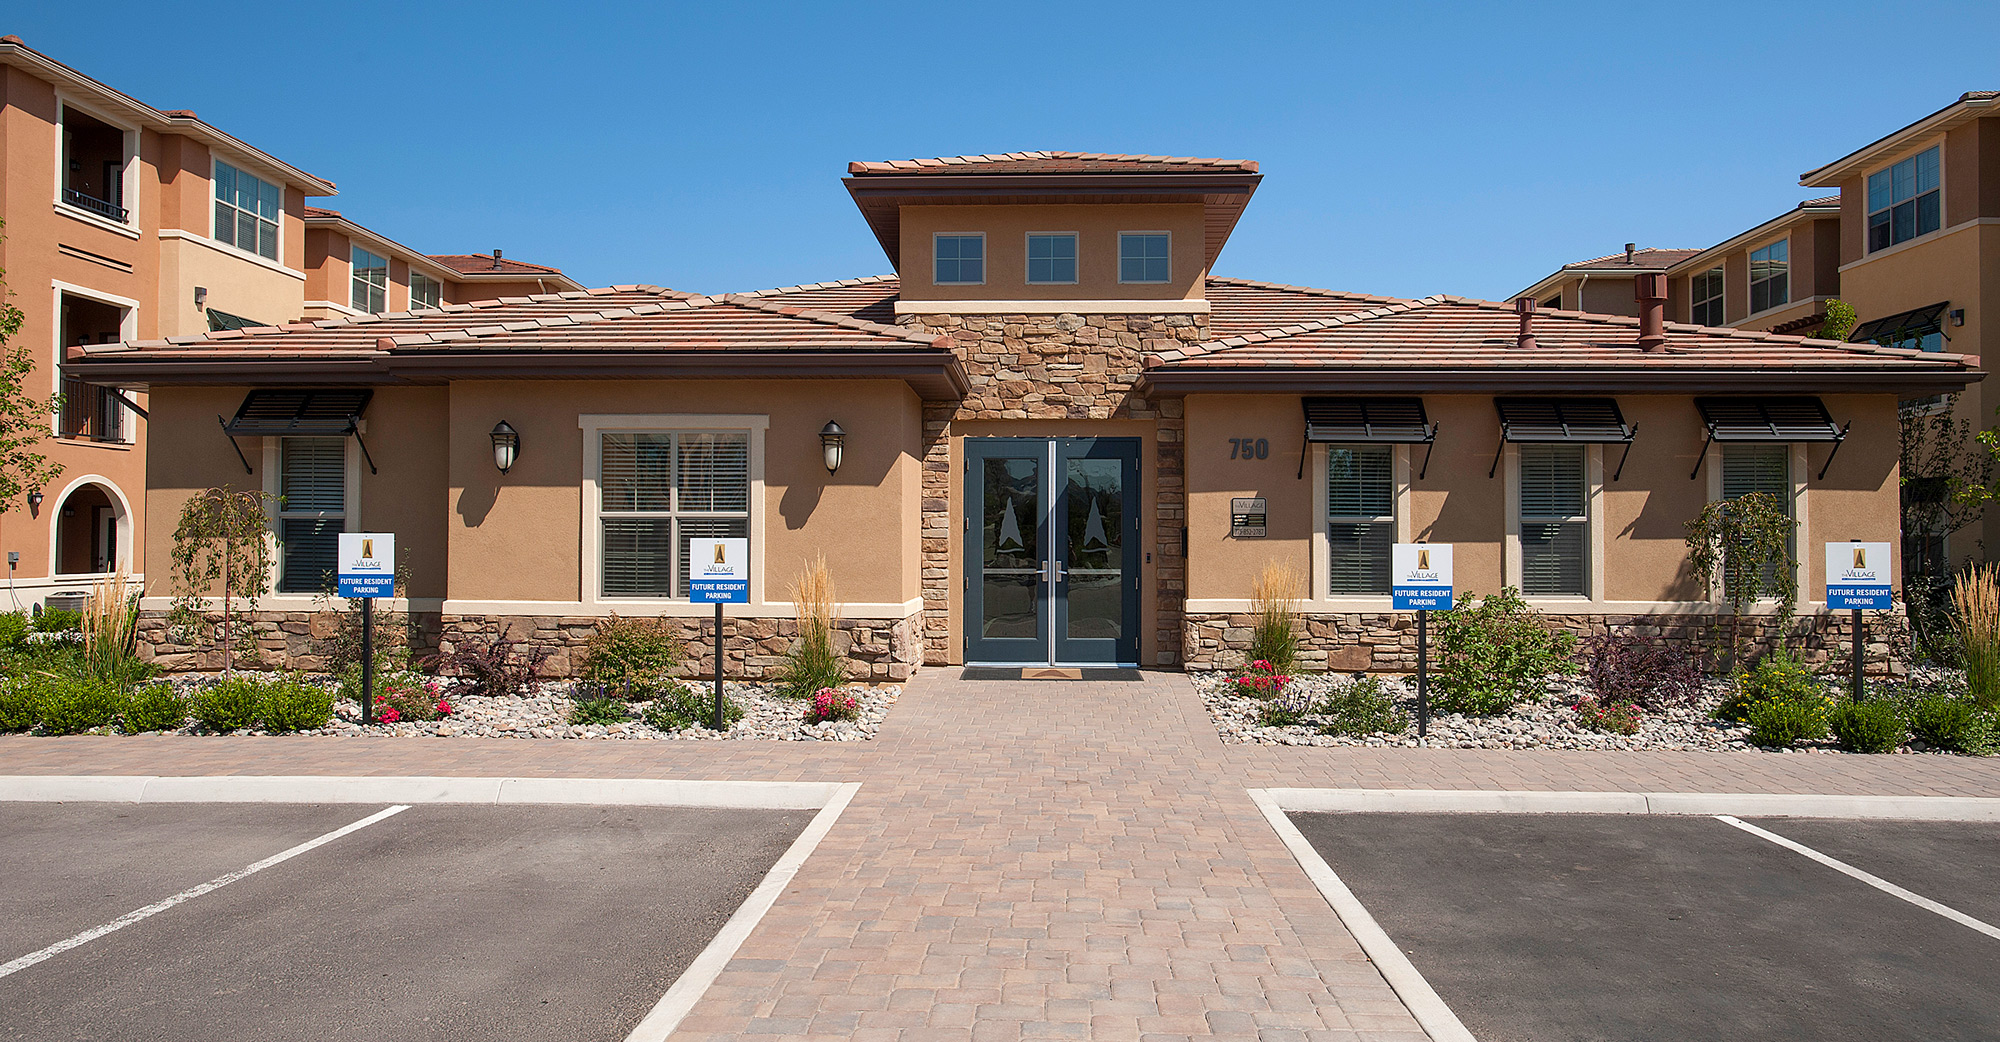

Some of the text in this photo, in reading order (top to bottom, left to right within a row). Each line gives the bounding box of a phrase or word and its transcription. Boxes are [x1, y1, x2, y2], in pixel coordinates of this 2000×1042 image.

[1229, 438, 1269, 460] 750
[356, 559, 381, 567] VILLAGE
[708, 564, 734, 572] VILLAGE
[1846, 569, 1876, 577] VILLAGE
